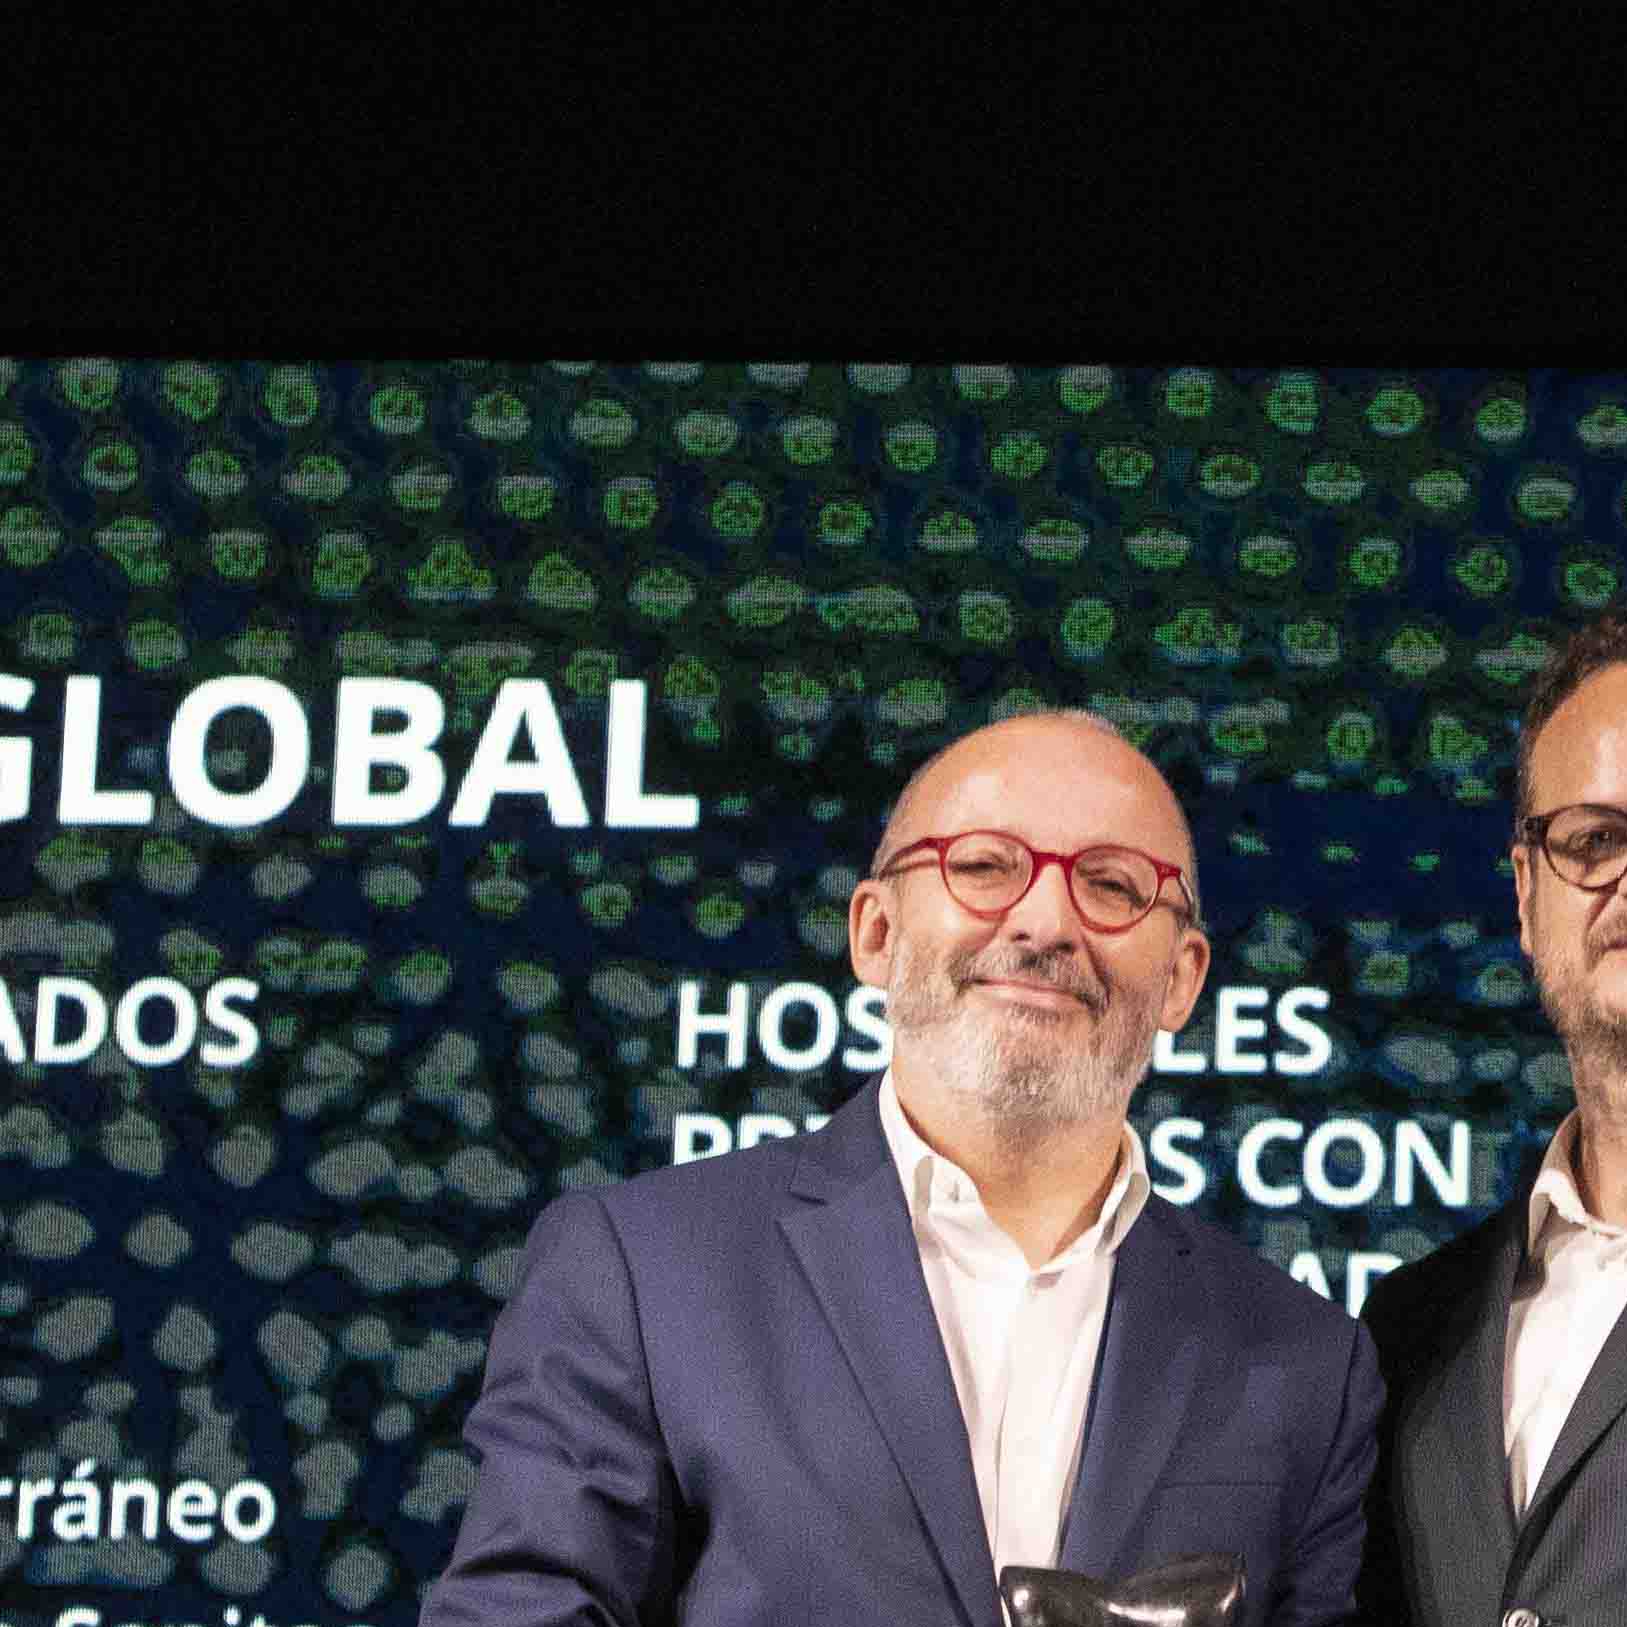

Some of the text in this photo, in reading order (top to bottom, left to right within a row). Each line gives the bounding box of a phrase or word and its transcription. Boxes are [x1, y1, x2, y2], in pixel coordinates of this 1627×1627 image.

[0, 672, 701, 830] LOBAL
[676, 981, 1332, 1075] HOSLES
[1236, 1116, 1472, 1208] CON
